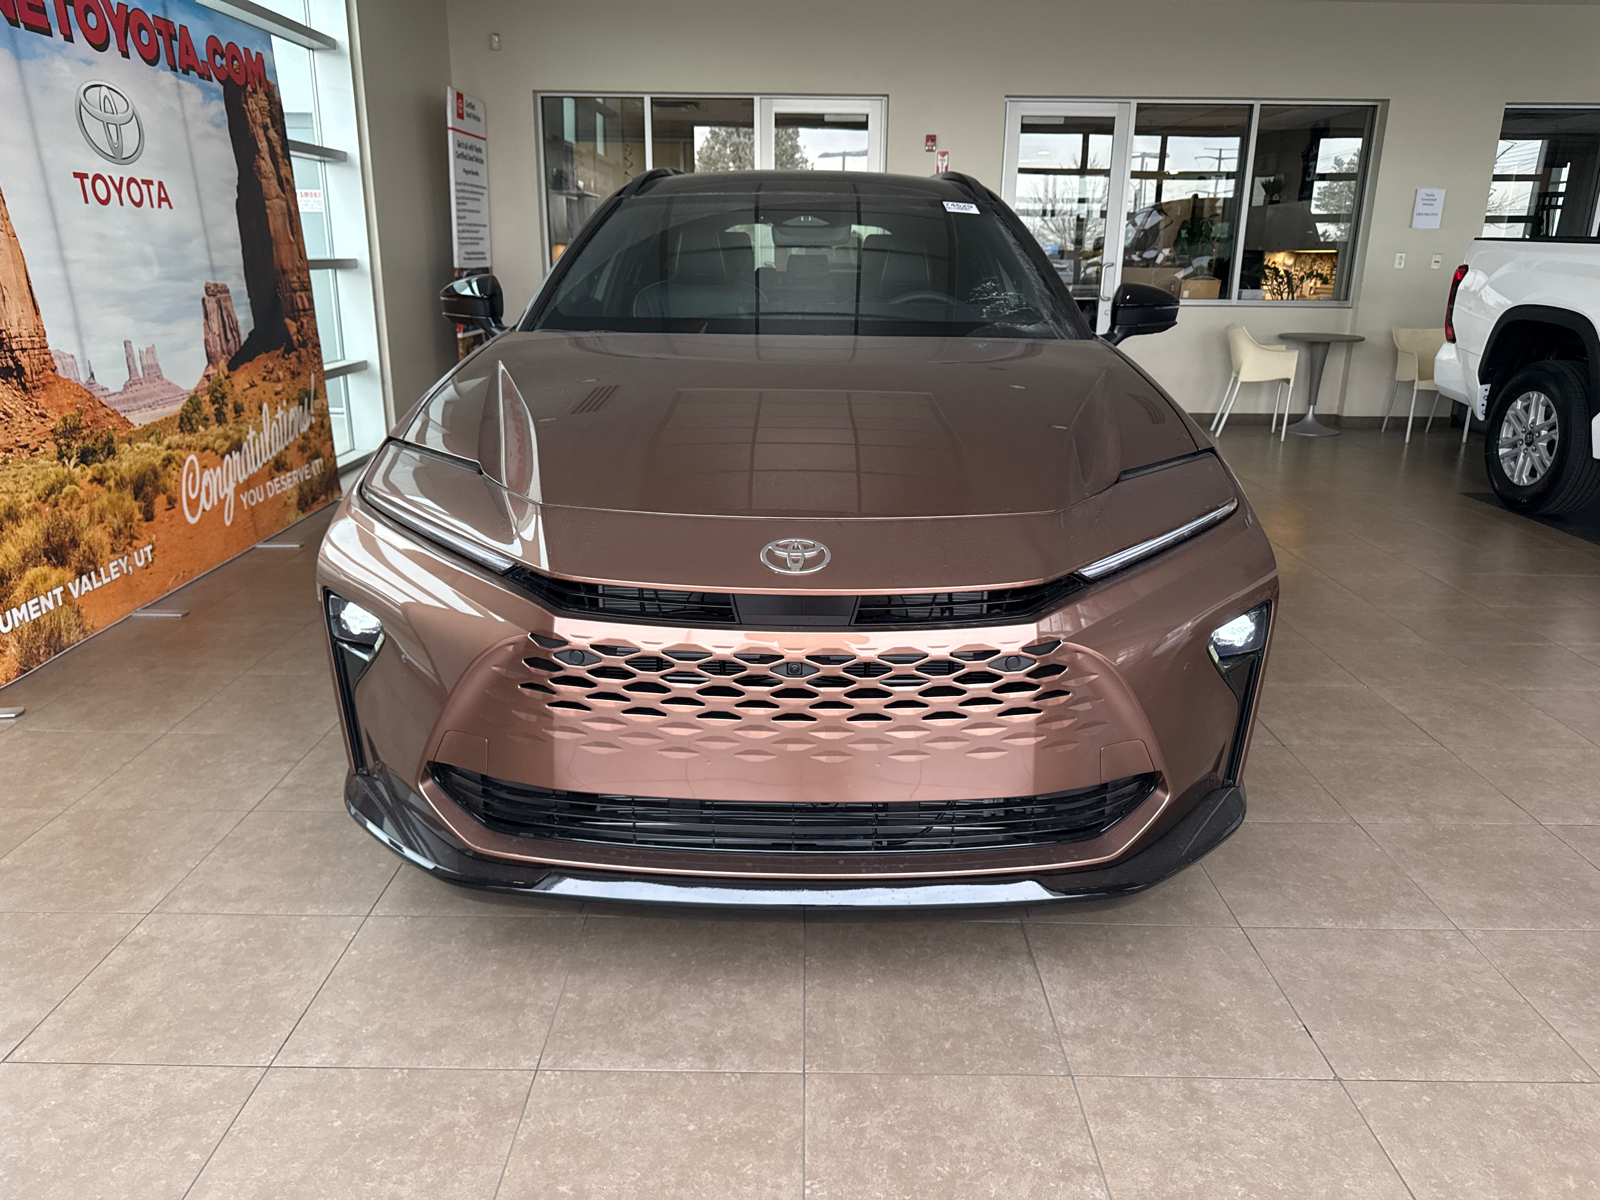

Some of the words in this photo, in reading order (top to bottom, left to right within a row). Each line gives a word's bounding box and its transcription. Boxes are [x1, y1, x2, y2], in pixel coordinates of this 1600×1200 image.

[72, 171, 173, 210] TOYOTA
[182, 372, 315, 526] Congratulations!
[240, 485, 265, 509] YOU
[266, 466, 311, 498] DESERVE
[311, 458, 325, 477] IT!
[67, 555, 133, 599] VALLEY,
[134, 544, 153, 567] UT
